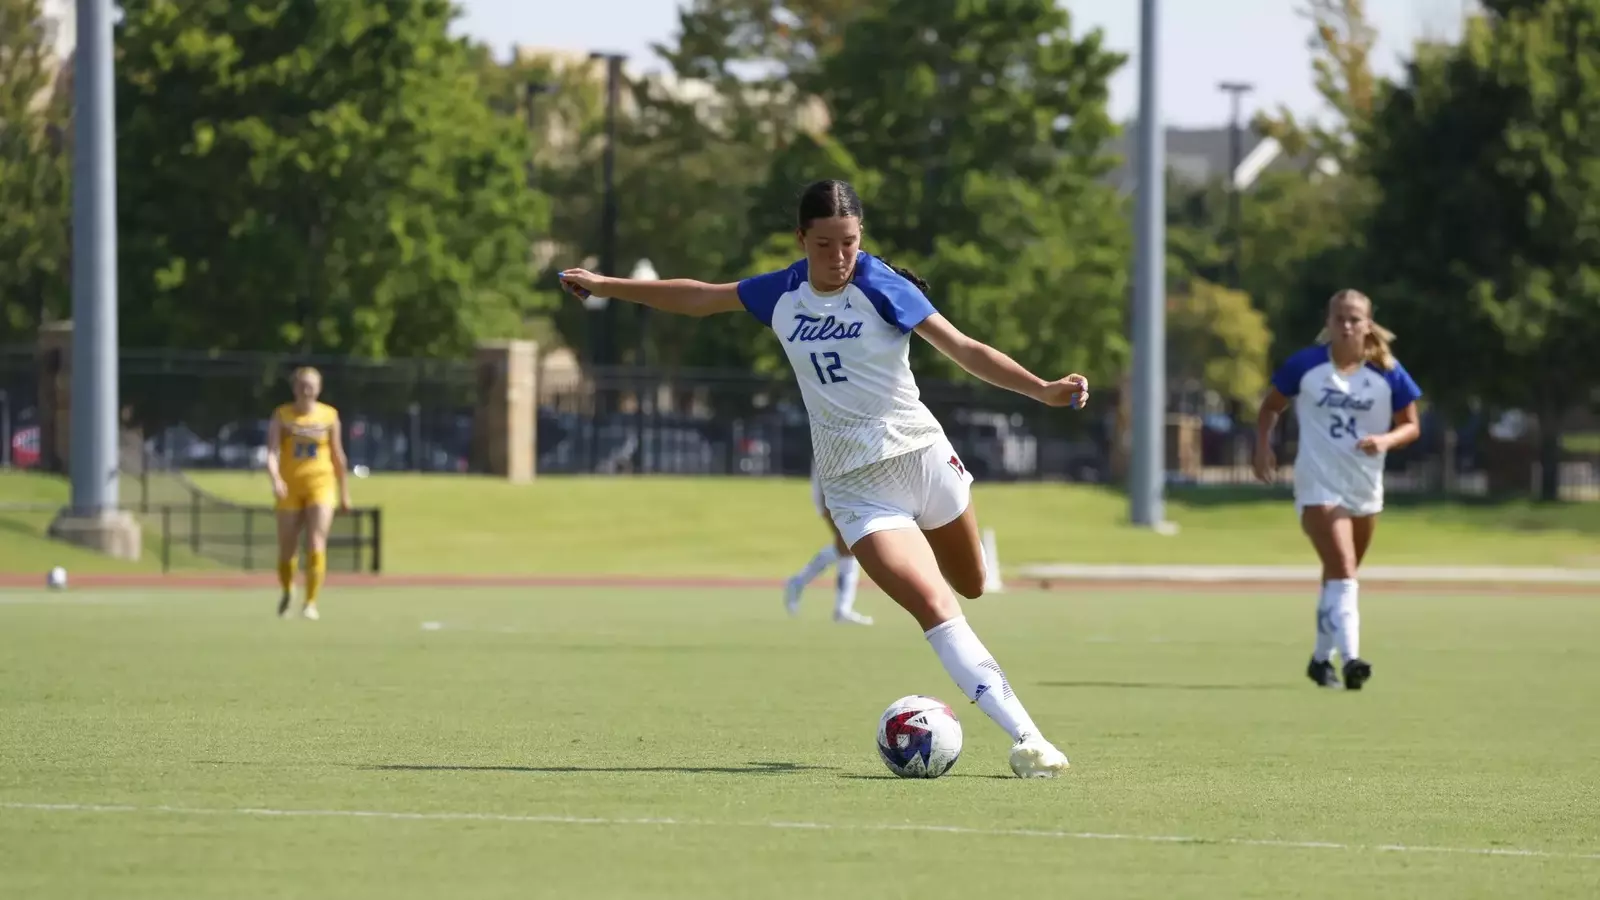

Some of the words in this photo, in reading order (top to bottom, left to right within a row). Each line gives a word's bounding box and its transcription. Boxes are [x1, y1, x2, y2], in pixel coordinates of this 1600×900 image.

[787, 314, 864, 342] Tulsa
[809, 351, 848, 385] 12
[1329, 413, 1358, 439] 24
